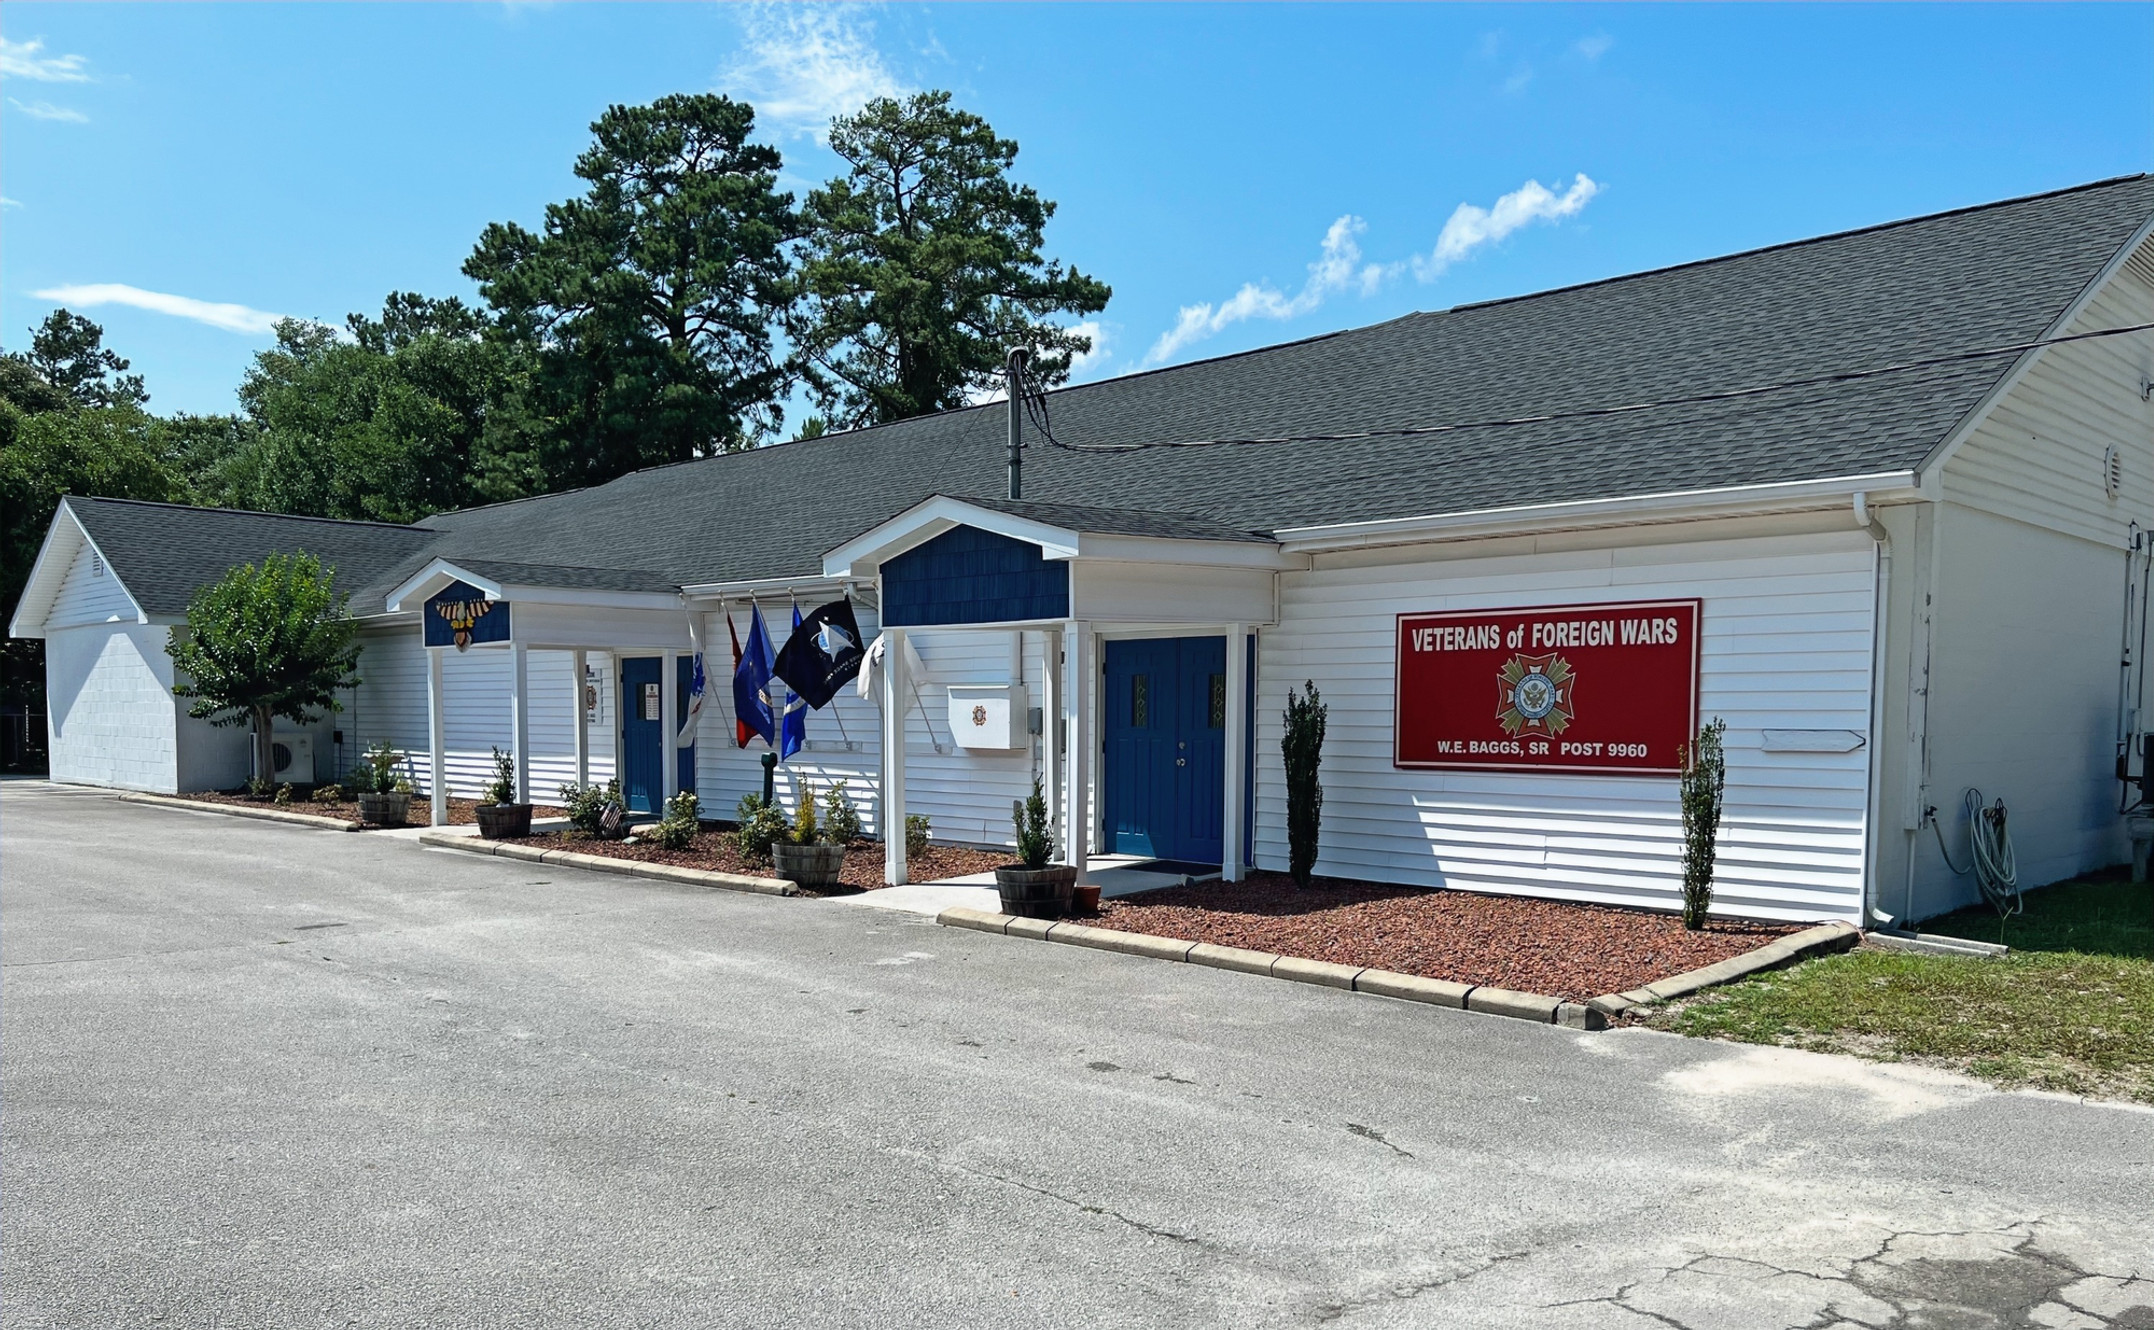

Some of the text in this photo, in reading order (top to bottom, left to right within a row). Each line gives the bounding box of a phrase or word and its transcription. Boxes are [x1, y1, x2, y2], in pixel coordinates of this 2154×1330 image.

[1411, 617, 1678, 652] VETERANS of FOREIGN WARS
[1437, 740, 1648, 758] W.E. BAGGS, SR POST 9960
